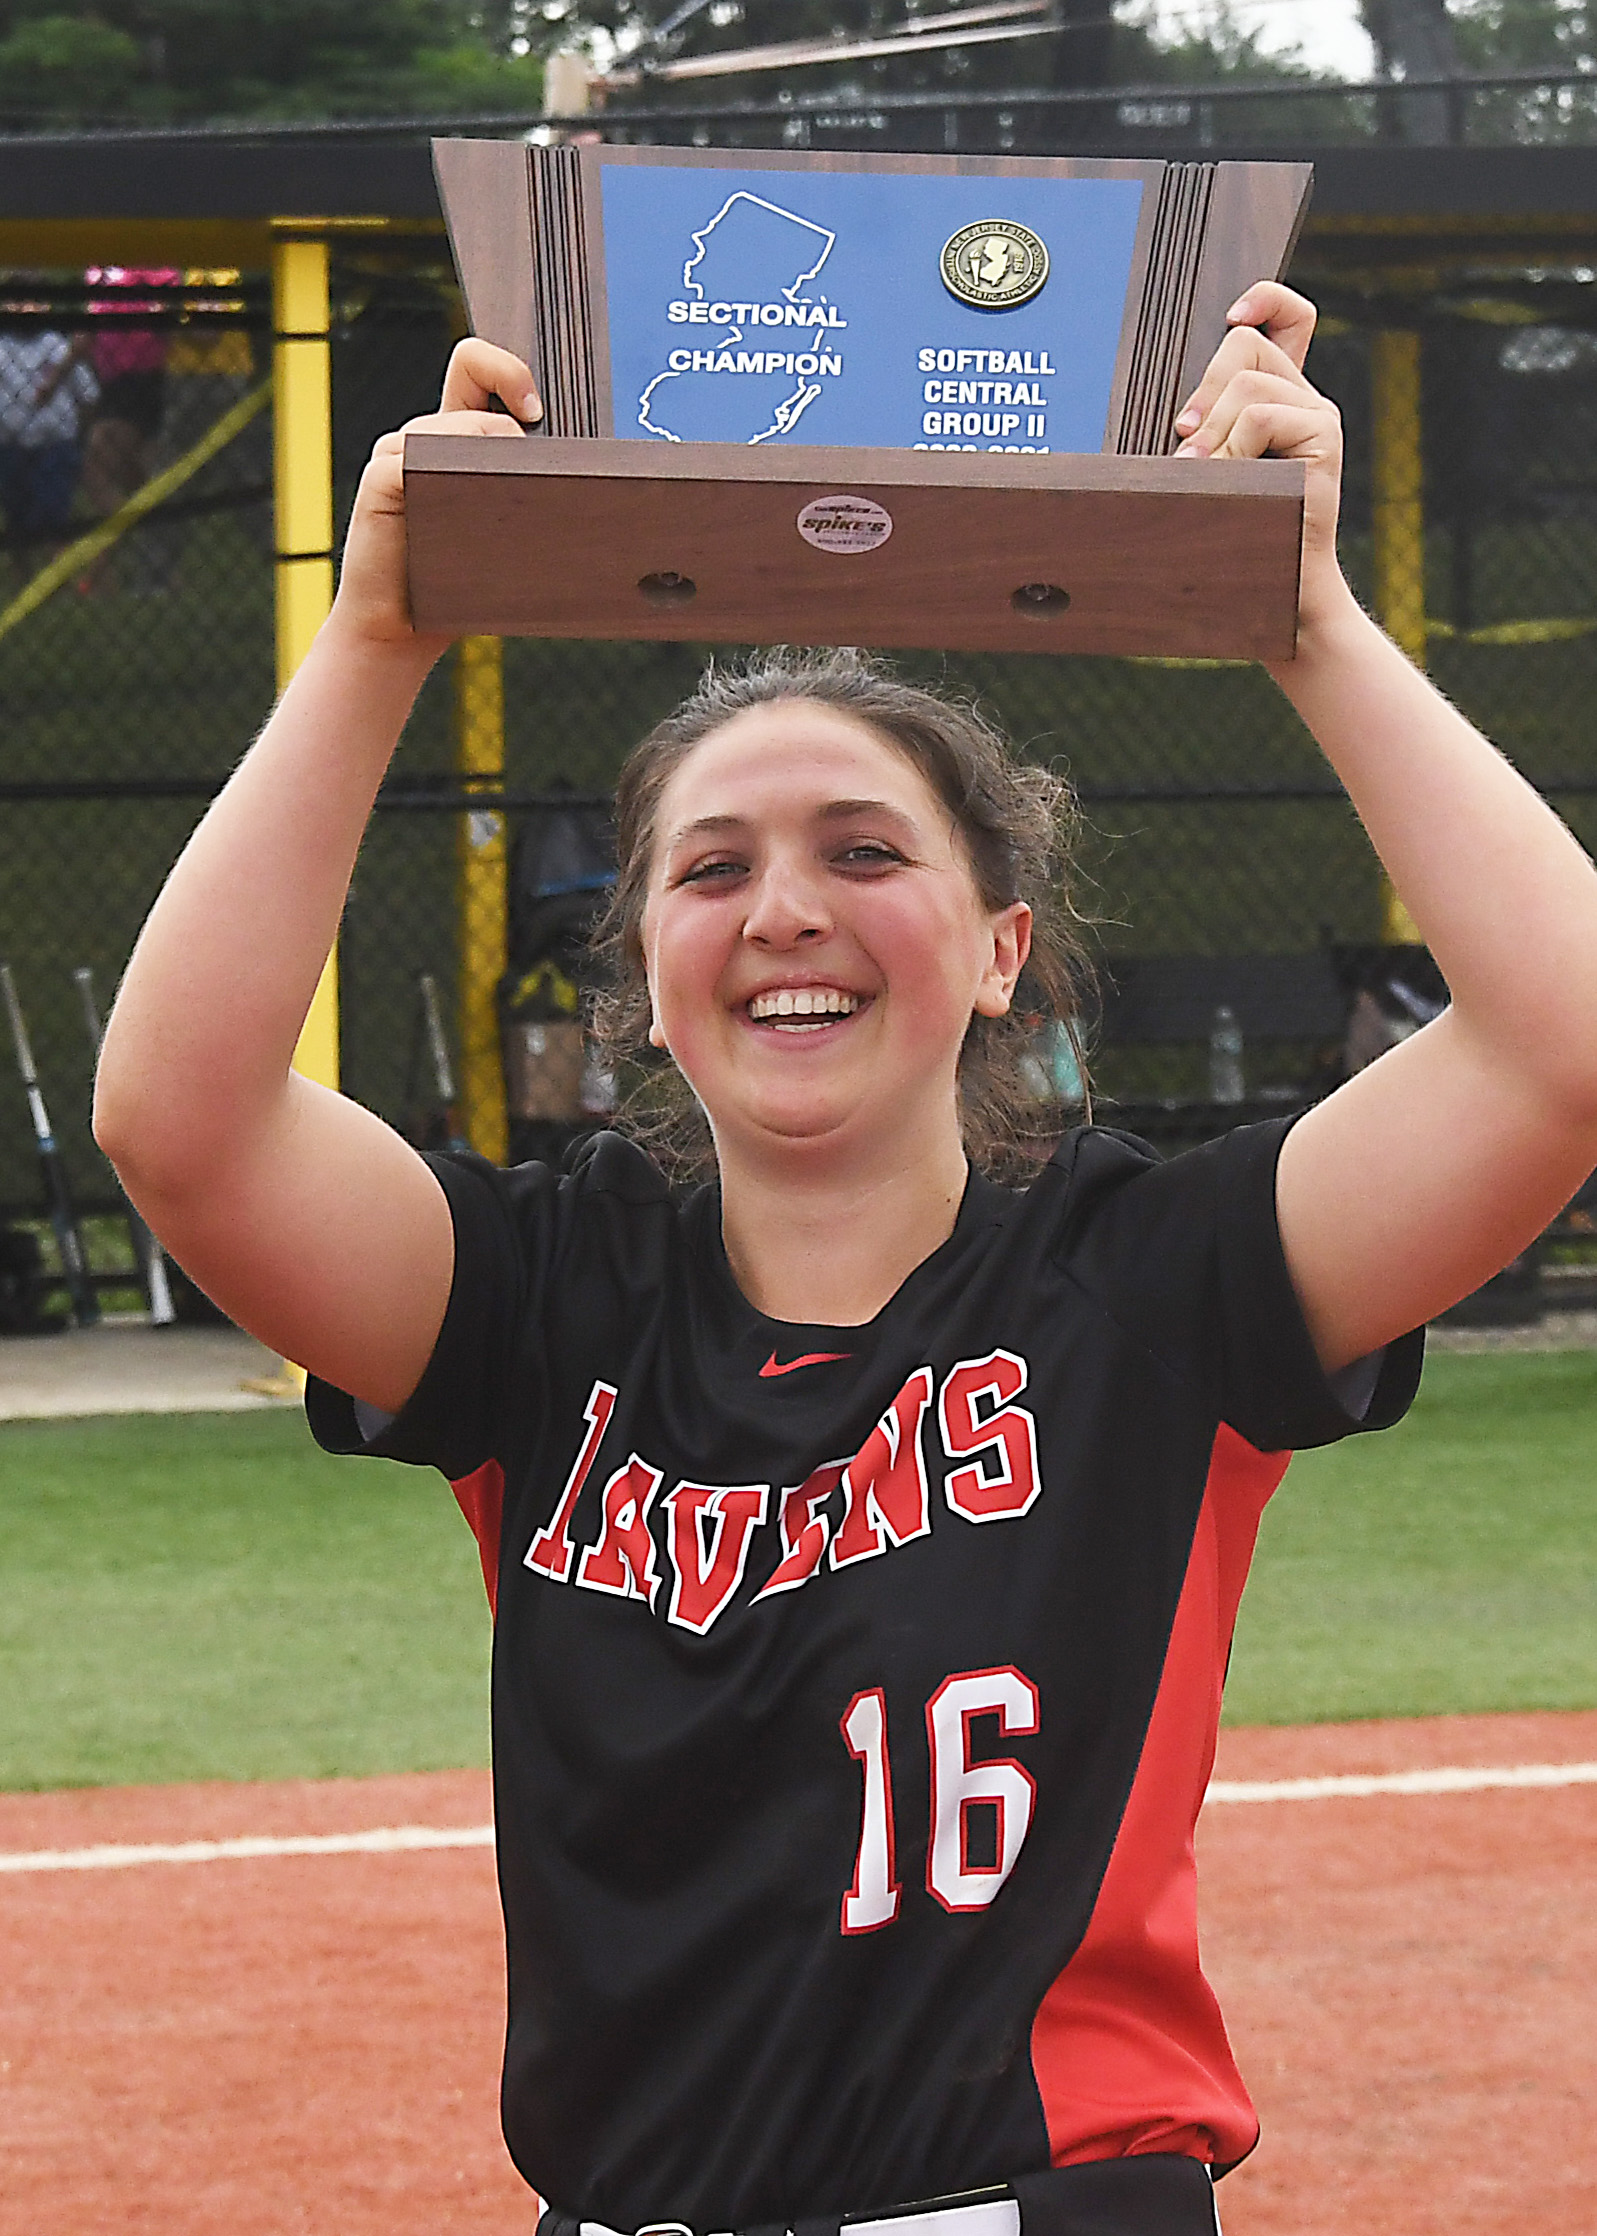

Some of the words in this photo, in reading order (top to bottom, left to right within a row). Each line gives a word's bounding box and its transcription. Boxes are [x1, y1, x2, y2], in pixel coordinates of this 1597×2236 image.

[667, 301, 847, 328] SECTIONAL
[668, 349, 842, 376] CHAMPION
[918, 348, 1056, 375] SOFTBALL
[924, 380, 1047, 406] CENTRAL
[923, 411, 1020, 437] GROUP
[1027, 414, 1045, 437] II
[839, 1664, 1041, 1936] 16
